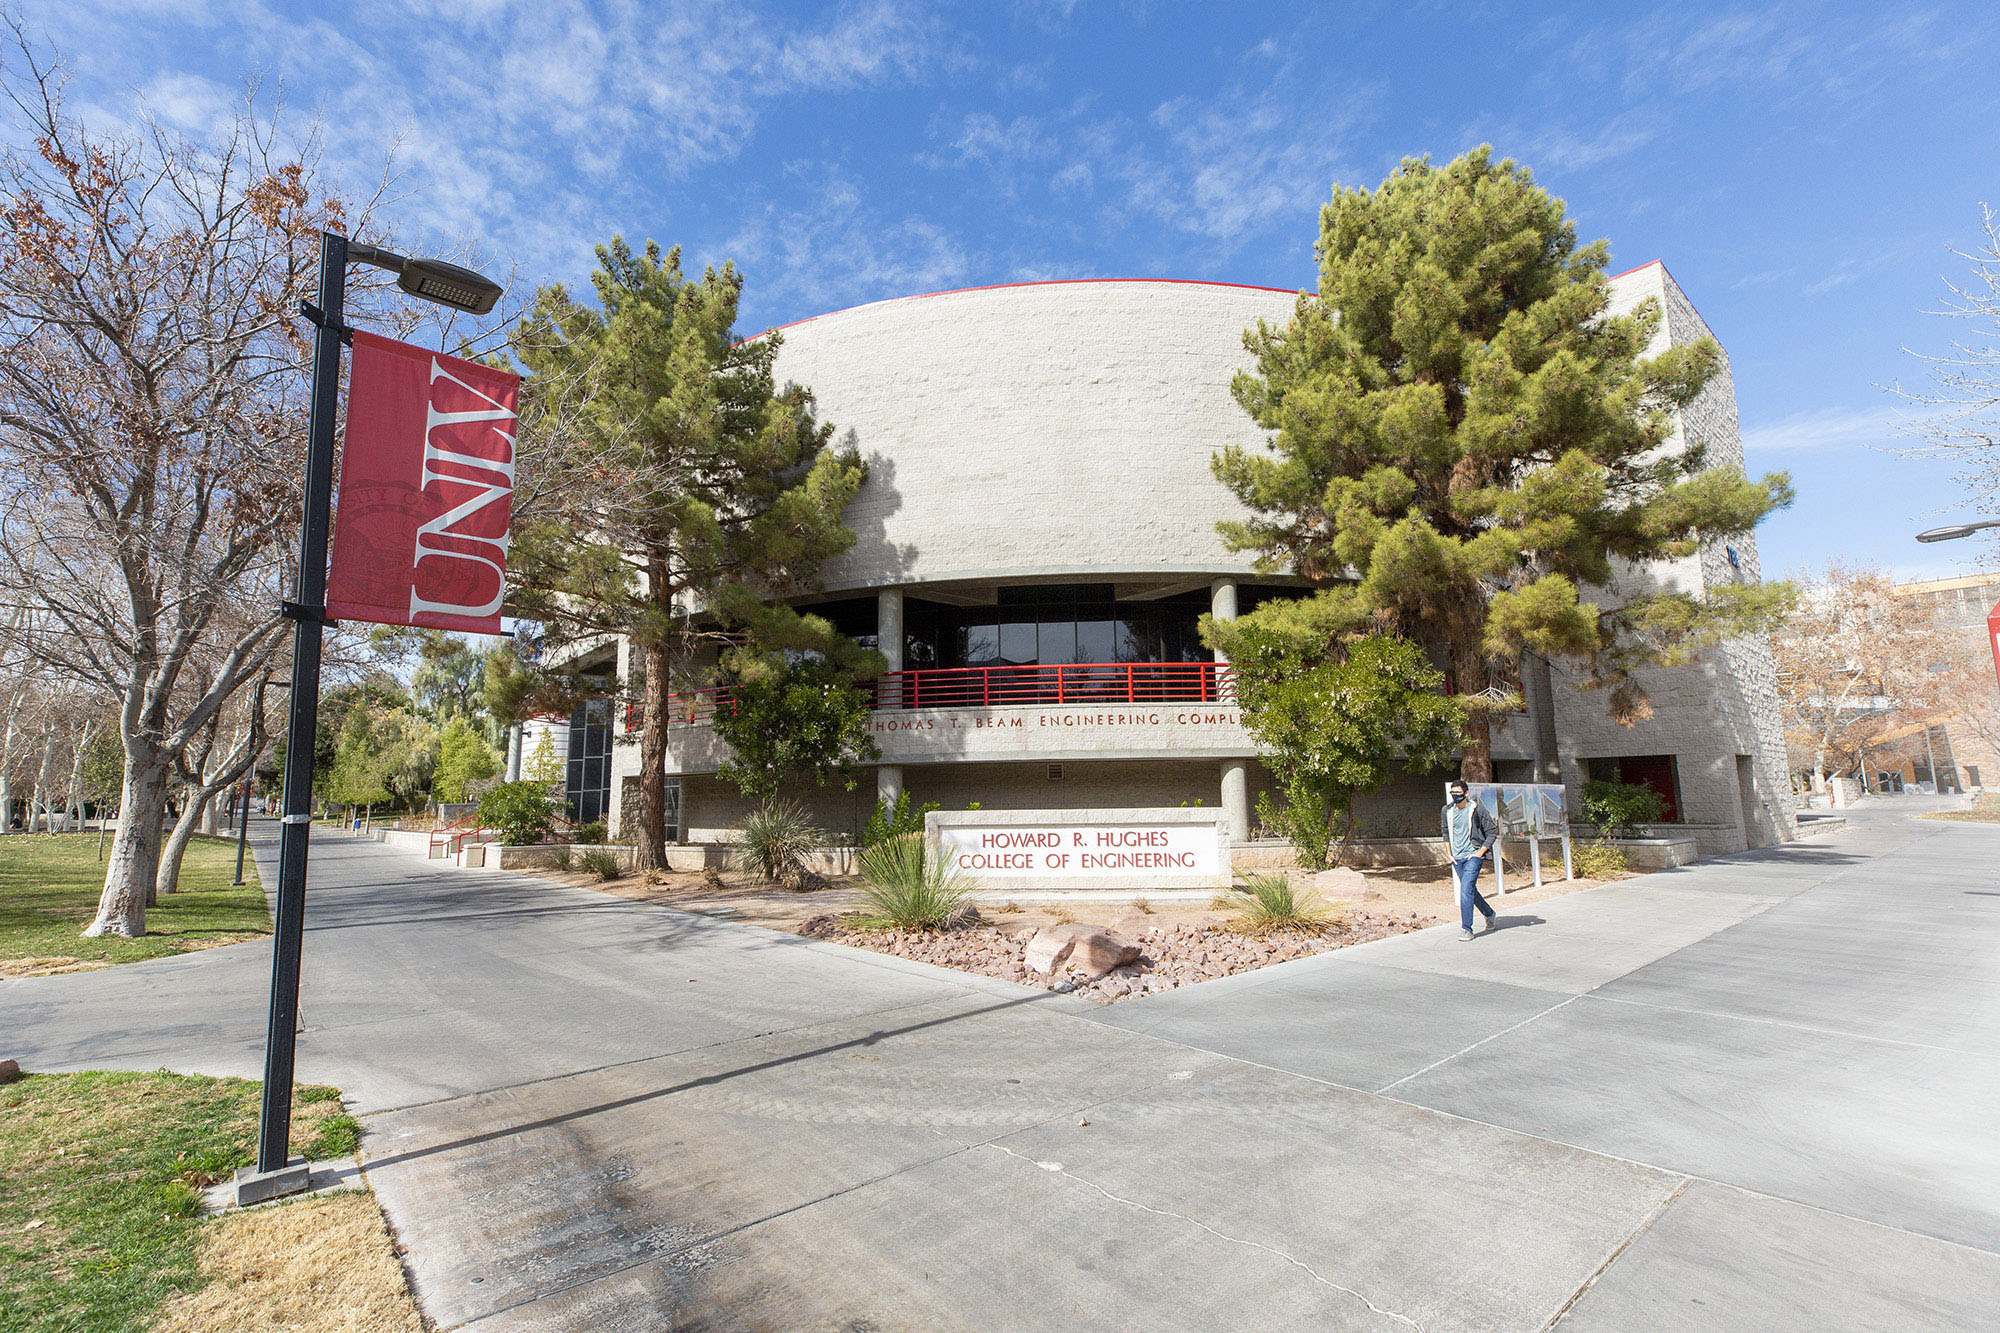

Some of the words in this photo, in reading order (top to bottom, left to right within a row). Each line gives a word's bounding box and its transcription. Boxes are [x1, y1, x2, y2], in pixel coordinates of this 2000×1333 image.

[409, 355, 518, 623] UNLV
[867, 719, 934, 732] THOMAS
[951, 718, 961, 729] T.
[976, 716, 1023, 728] BEAM
[1040, 713, 1160, 727] ENGINEERING
[1177, 713, 1246, 725] COMPLE
[982, 833, 1061, 848] HOWARD
[1074, 832, 1088, 847] R.
[1097, 831, 1169, 847] HUGHES
[958, 854, 1034, 870] COLLEGE
[1045, 853, 1070, 869] OF
[1081, 852, 1196, 868] ENGINEERING
